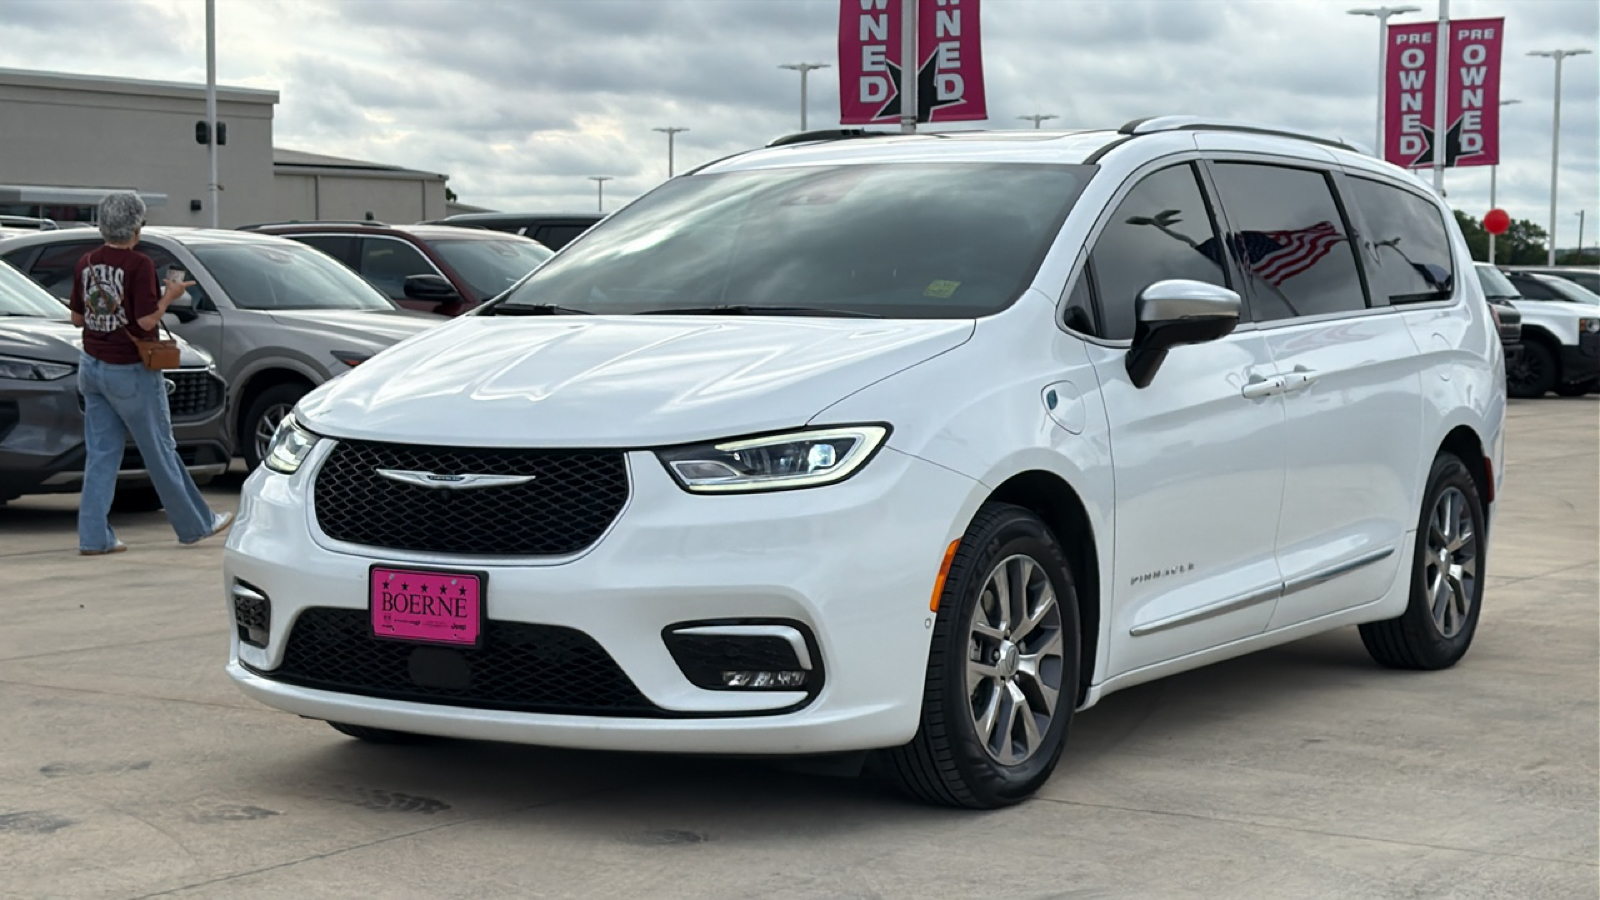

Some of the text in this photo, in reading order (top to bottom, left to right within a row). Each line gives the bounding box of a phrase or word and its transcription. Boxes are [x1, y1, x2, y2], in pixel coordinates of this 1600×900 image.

[935, 0, 965, 101] NED
[1395, 32, 1432, 45] PRE
[1458, 28, 1495, 41] PRE
[1398, 48, 1426, 155] OWNED
[1460, 44, 1488, 152] OWNED
[382, 592, 468, 618] BOERNE
